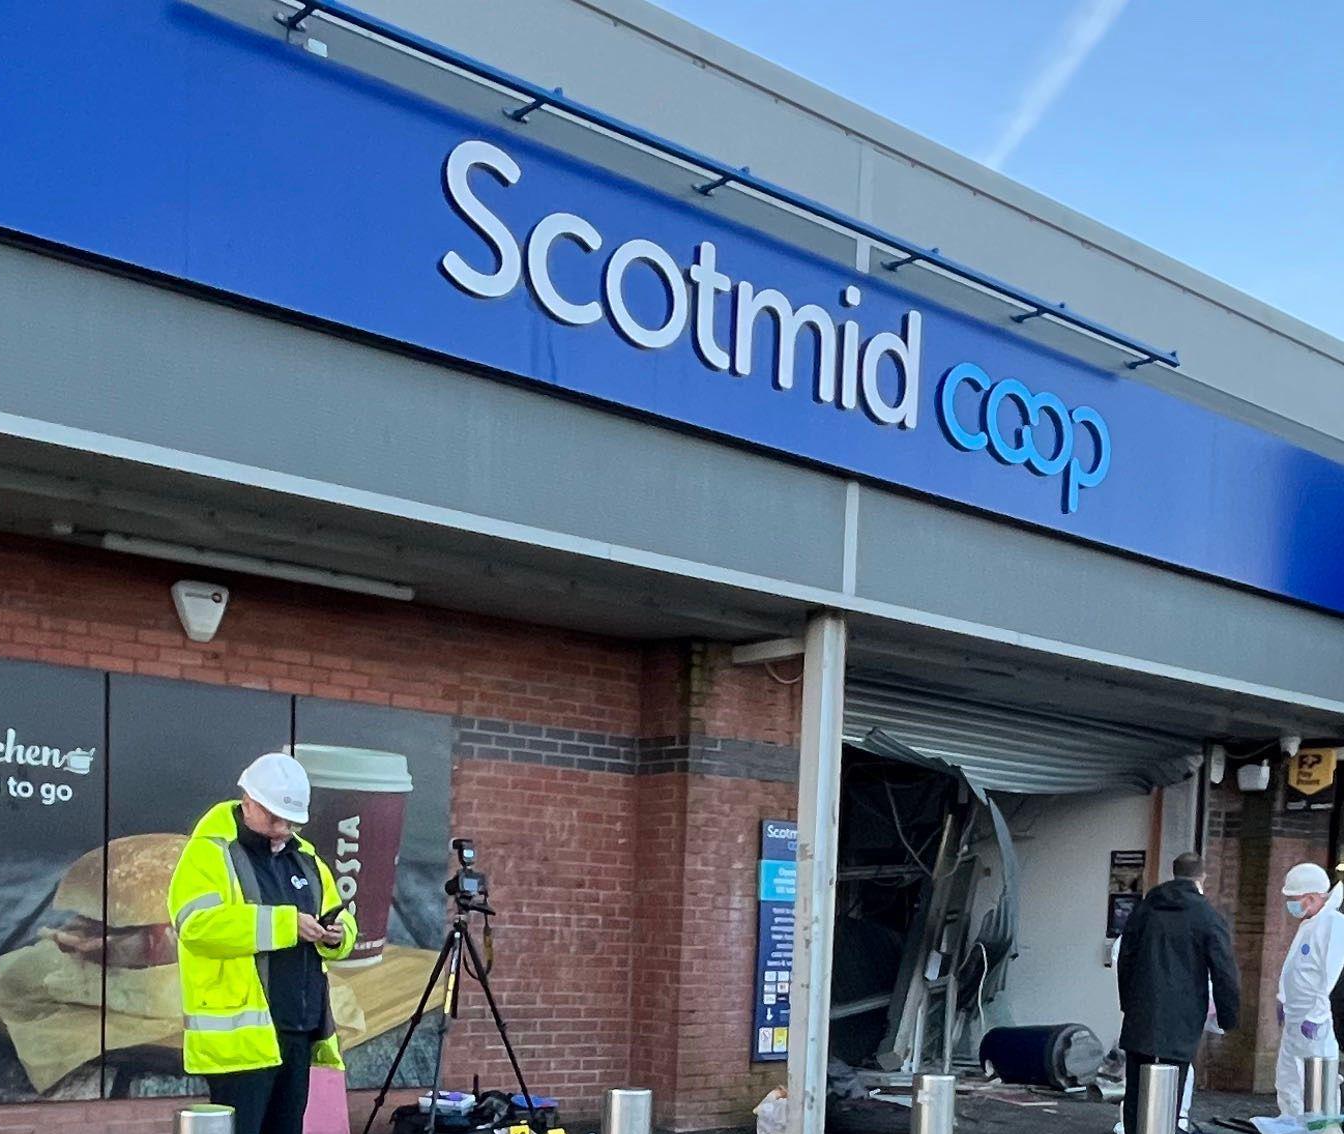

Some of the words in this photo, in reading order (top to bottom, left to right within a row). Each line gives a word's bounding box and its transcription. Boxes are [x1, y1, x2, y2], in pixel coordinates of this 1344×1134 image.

[441, 139, 923, 429] Scotmid
[941, 362, 1111, 513] coop
[7, 775, 34, 799] to
[40, 782, 73, 806] go
[767, 824, 798, 838] Scotm
[334, 815, 362, 916] OSTA
